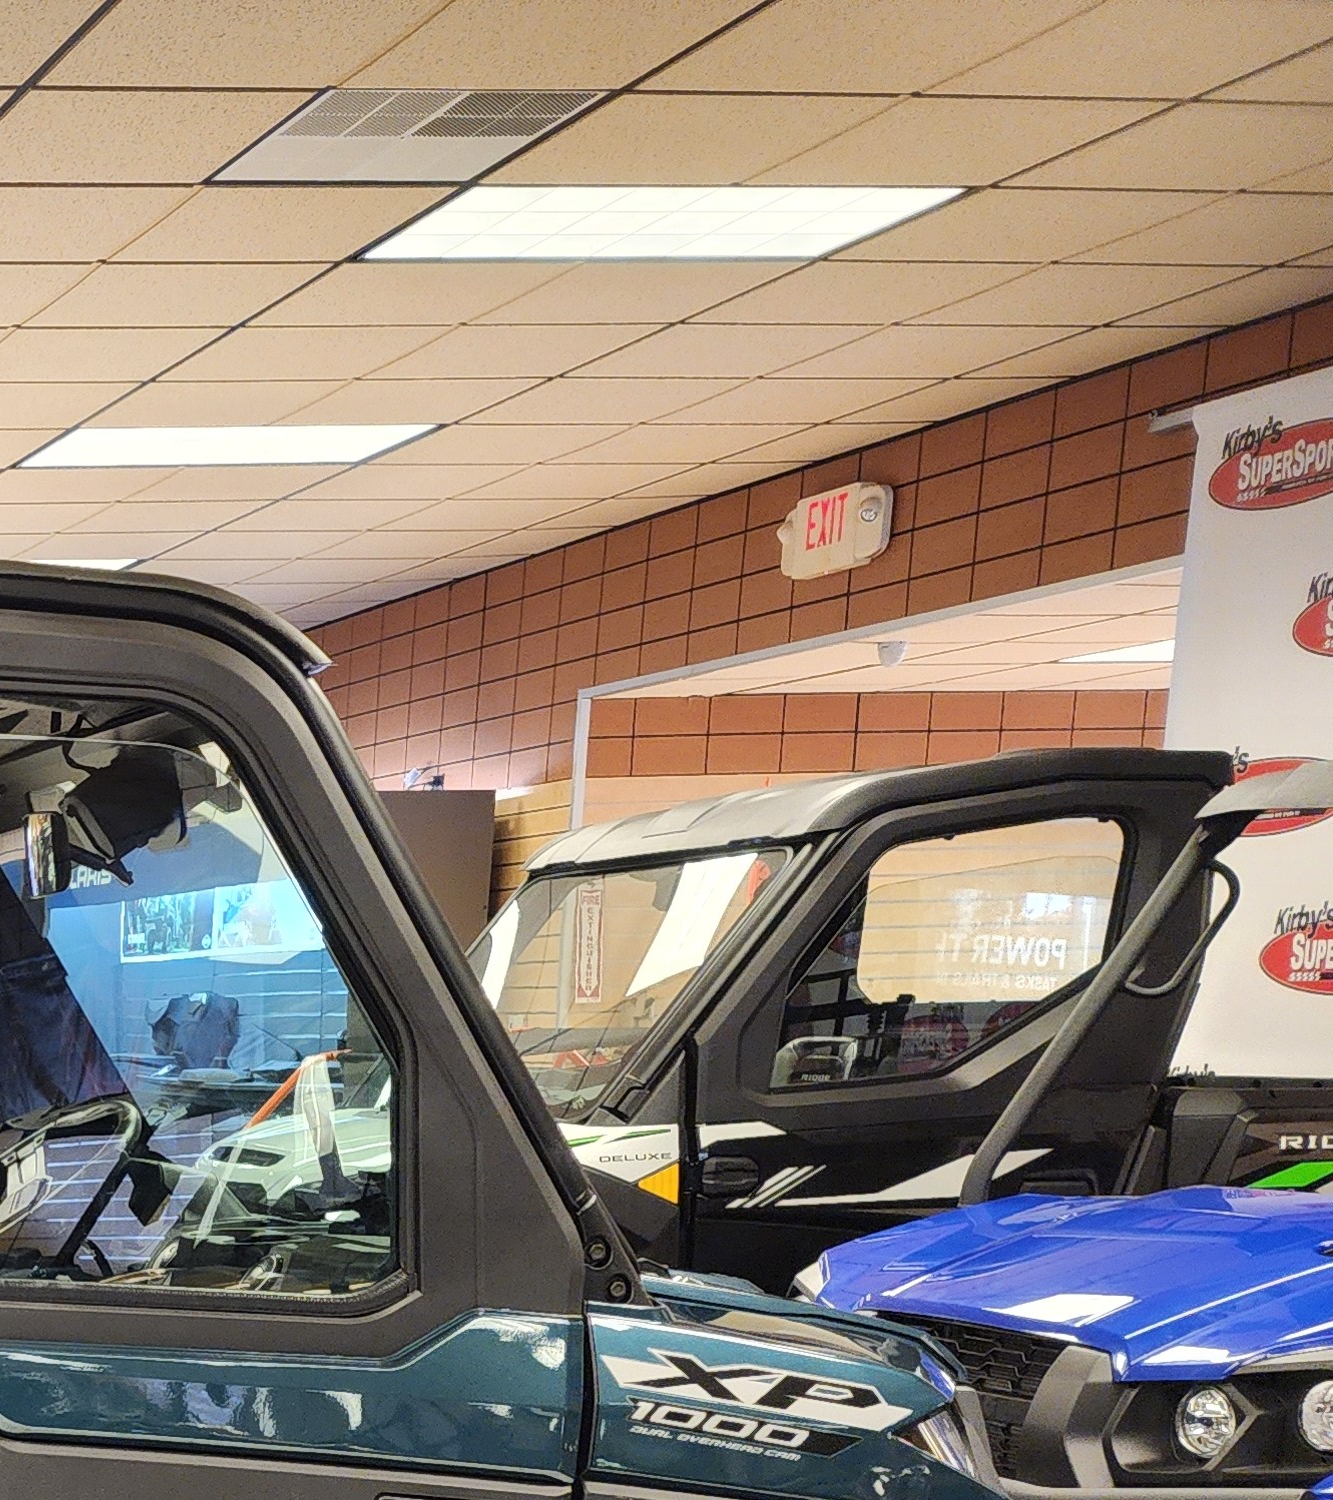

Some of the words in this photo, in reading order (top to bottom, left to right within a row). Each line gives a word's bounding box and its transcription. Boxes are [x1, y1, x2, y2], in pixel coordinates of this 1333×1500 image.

[805, 492, 849, 551] EXIT
[599, 1152, 673, 1163] DELUXE
[621, 1348, 889, 1411] XP
[629, 1401, 810, 1448] 1000
[629, 1425, 674, 1440] DUAL
[676, 1434, 764, 1454] OVERHEAD
[764, 1449, 802, 1462] CAM
